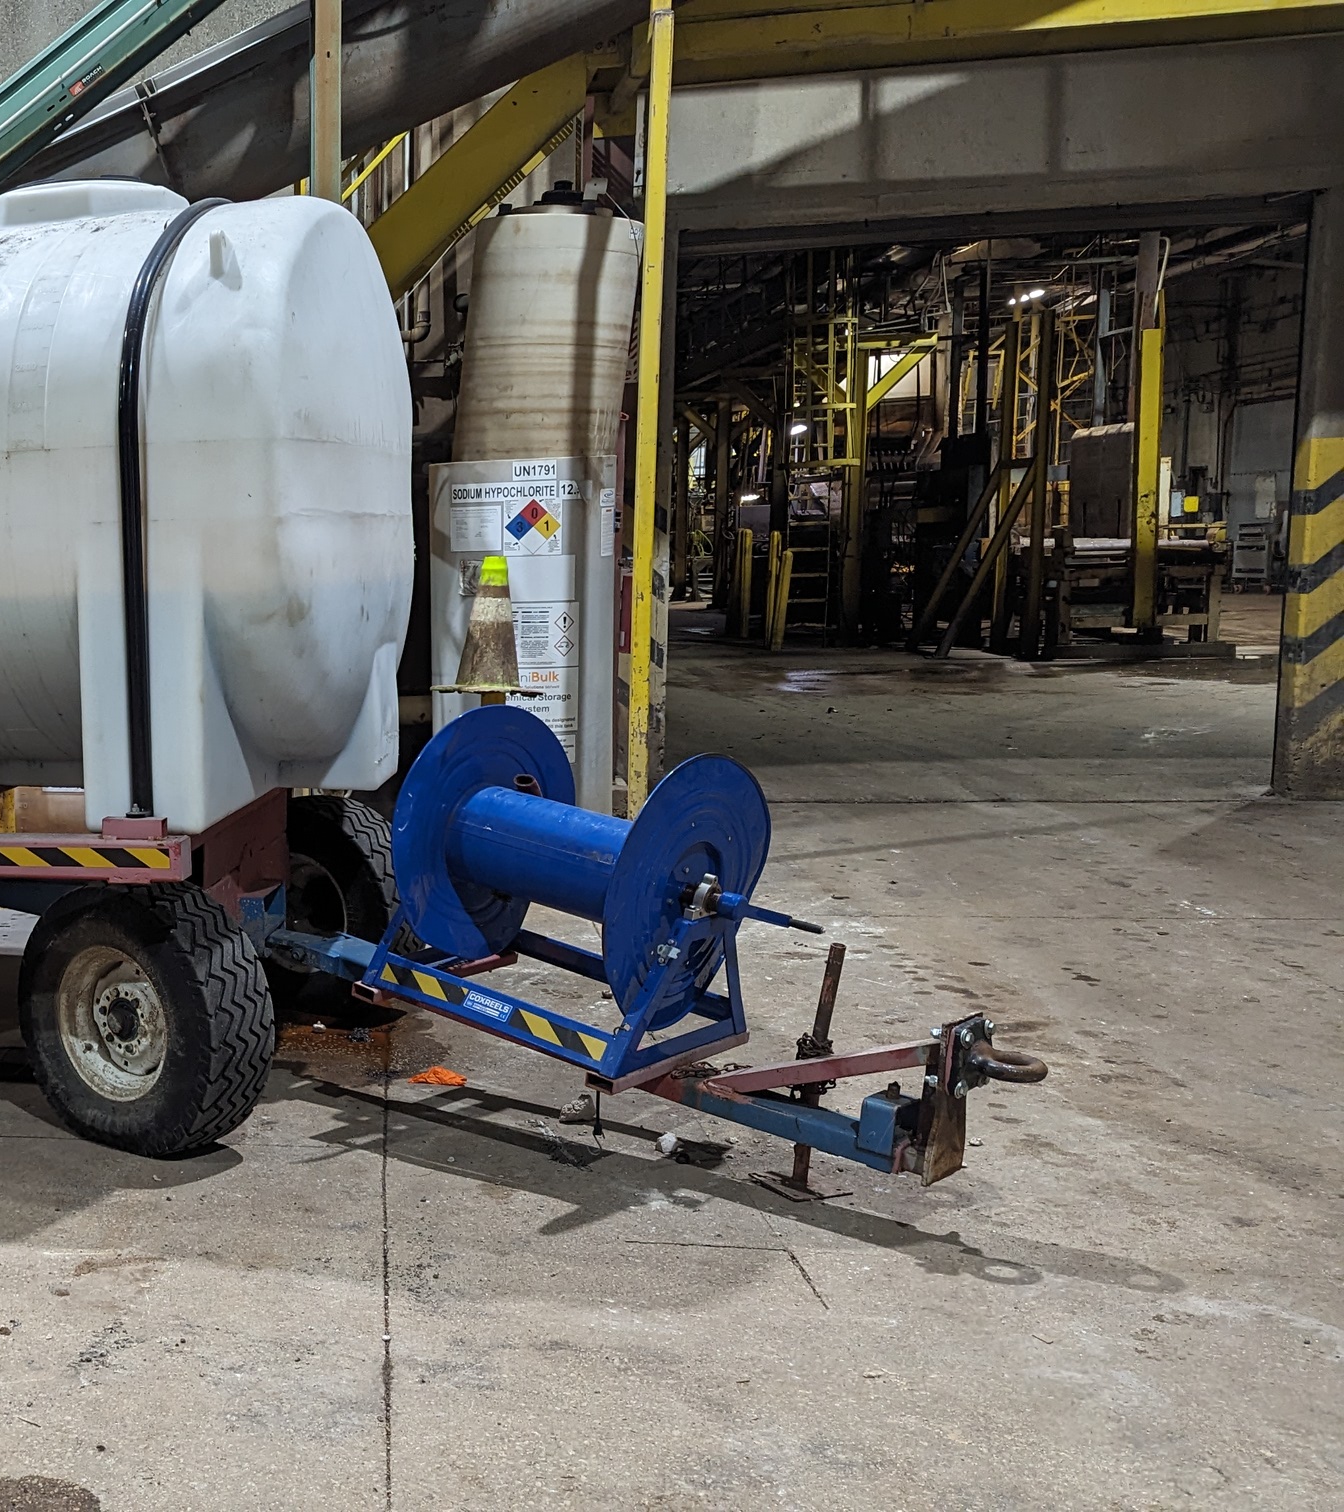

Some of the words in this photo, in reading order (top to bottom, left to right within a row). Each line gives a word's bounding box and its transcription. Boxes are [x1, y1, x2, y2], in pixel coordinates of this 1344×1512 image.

[514, 464, 556, 477] UN1791
[452, 487, 482, 500] SODIUM
[484, 485, 555, 499] HYPOCHLORITE
[561, 483, 580, 495] 12.
[531, 507, 538, 519] 0
[516, 521, 524, 533] 3
[544, 520, 549, 532] 1
[520, 671, 559, 682] niBulk
[469, 993, 509, 1013] COXREELS
